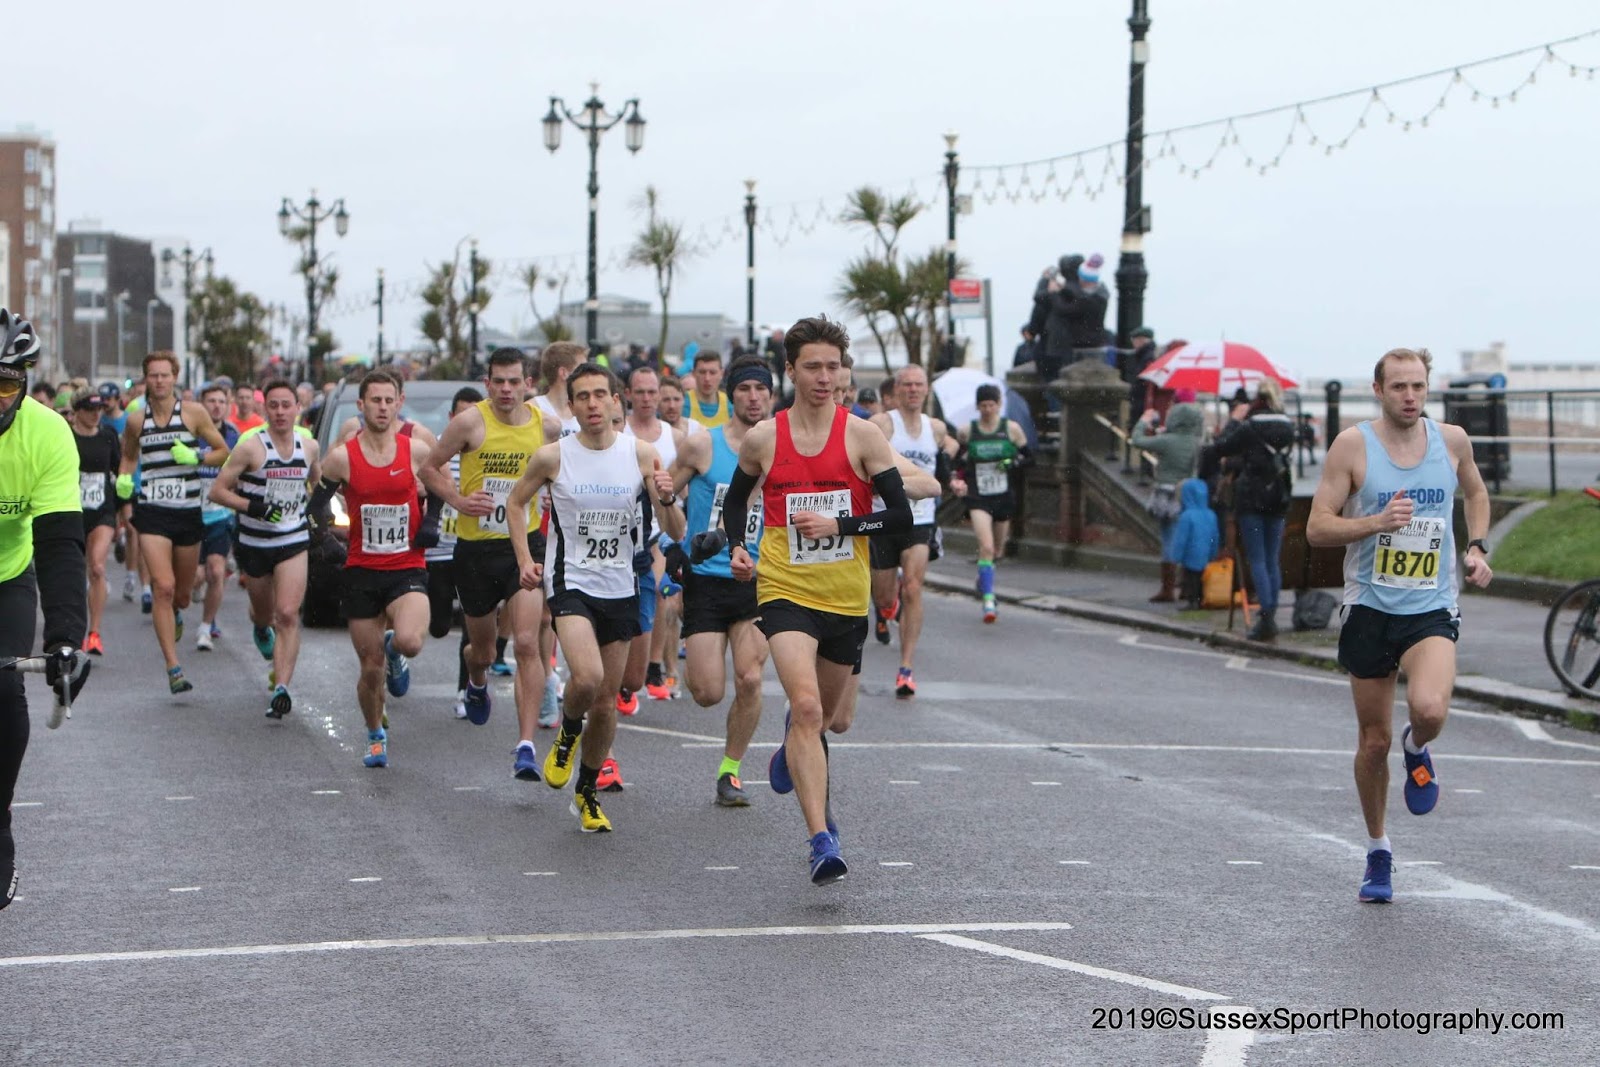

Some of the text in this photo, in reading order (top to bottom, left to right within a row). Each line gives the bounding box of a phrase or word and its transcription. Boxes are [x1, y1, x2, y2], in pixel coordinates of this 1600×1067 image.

[145, 433, 181, 443] FULHAM
[266, 468, 303, 478] BRISTOL
[483, 466, 519, 474] CRAWLEY
[486, 480, 515, 490] WORTHI
[572, 484, 632, 497] J.P.Morgan
[151, 484, 182, 500] 1582
[790, 494, 835, 507] WORTHING
[580, 512, 620, 521] WORTHING
[368, 526, 405, 544] 1144
[586, 538, 619, 559] 283
[1381, 548, 1435, 577] 1870
